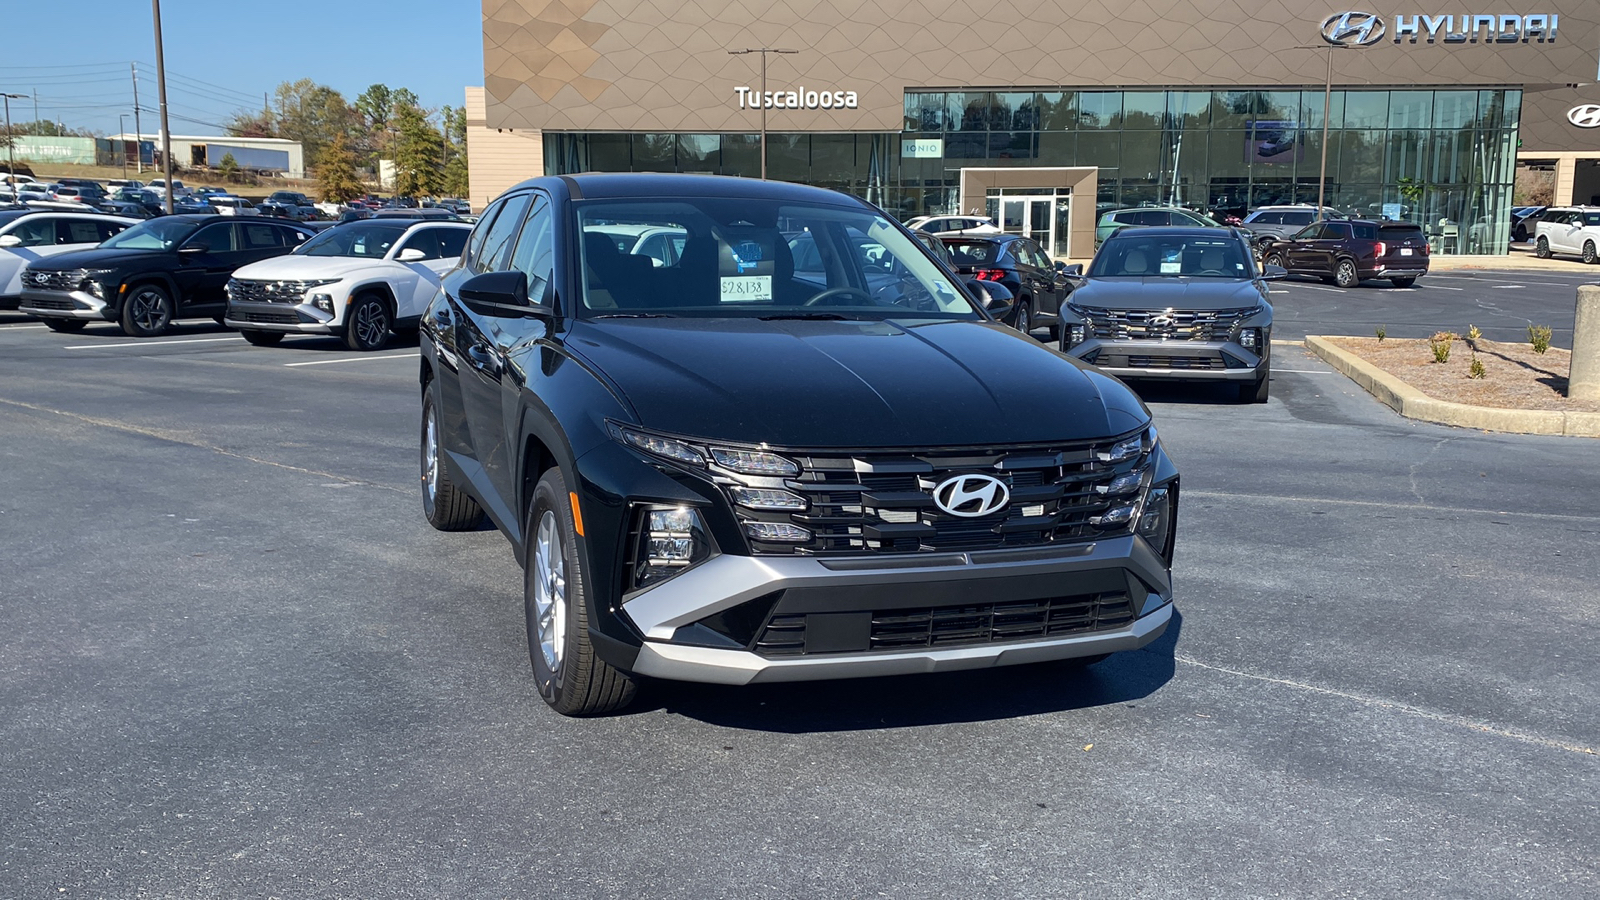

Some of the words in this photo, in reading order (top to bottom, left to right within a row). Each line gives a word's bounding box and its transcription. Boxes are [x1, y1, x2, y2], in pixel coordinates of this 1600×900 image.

[1394, 14, 1559, 43] HYUNDAI
[734, 86, 858, 109] Tuscaloosa
[721, 281, 762, 294] $28,138
